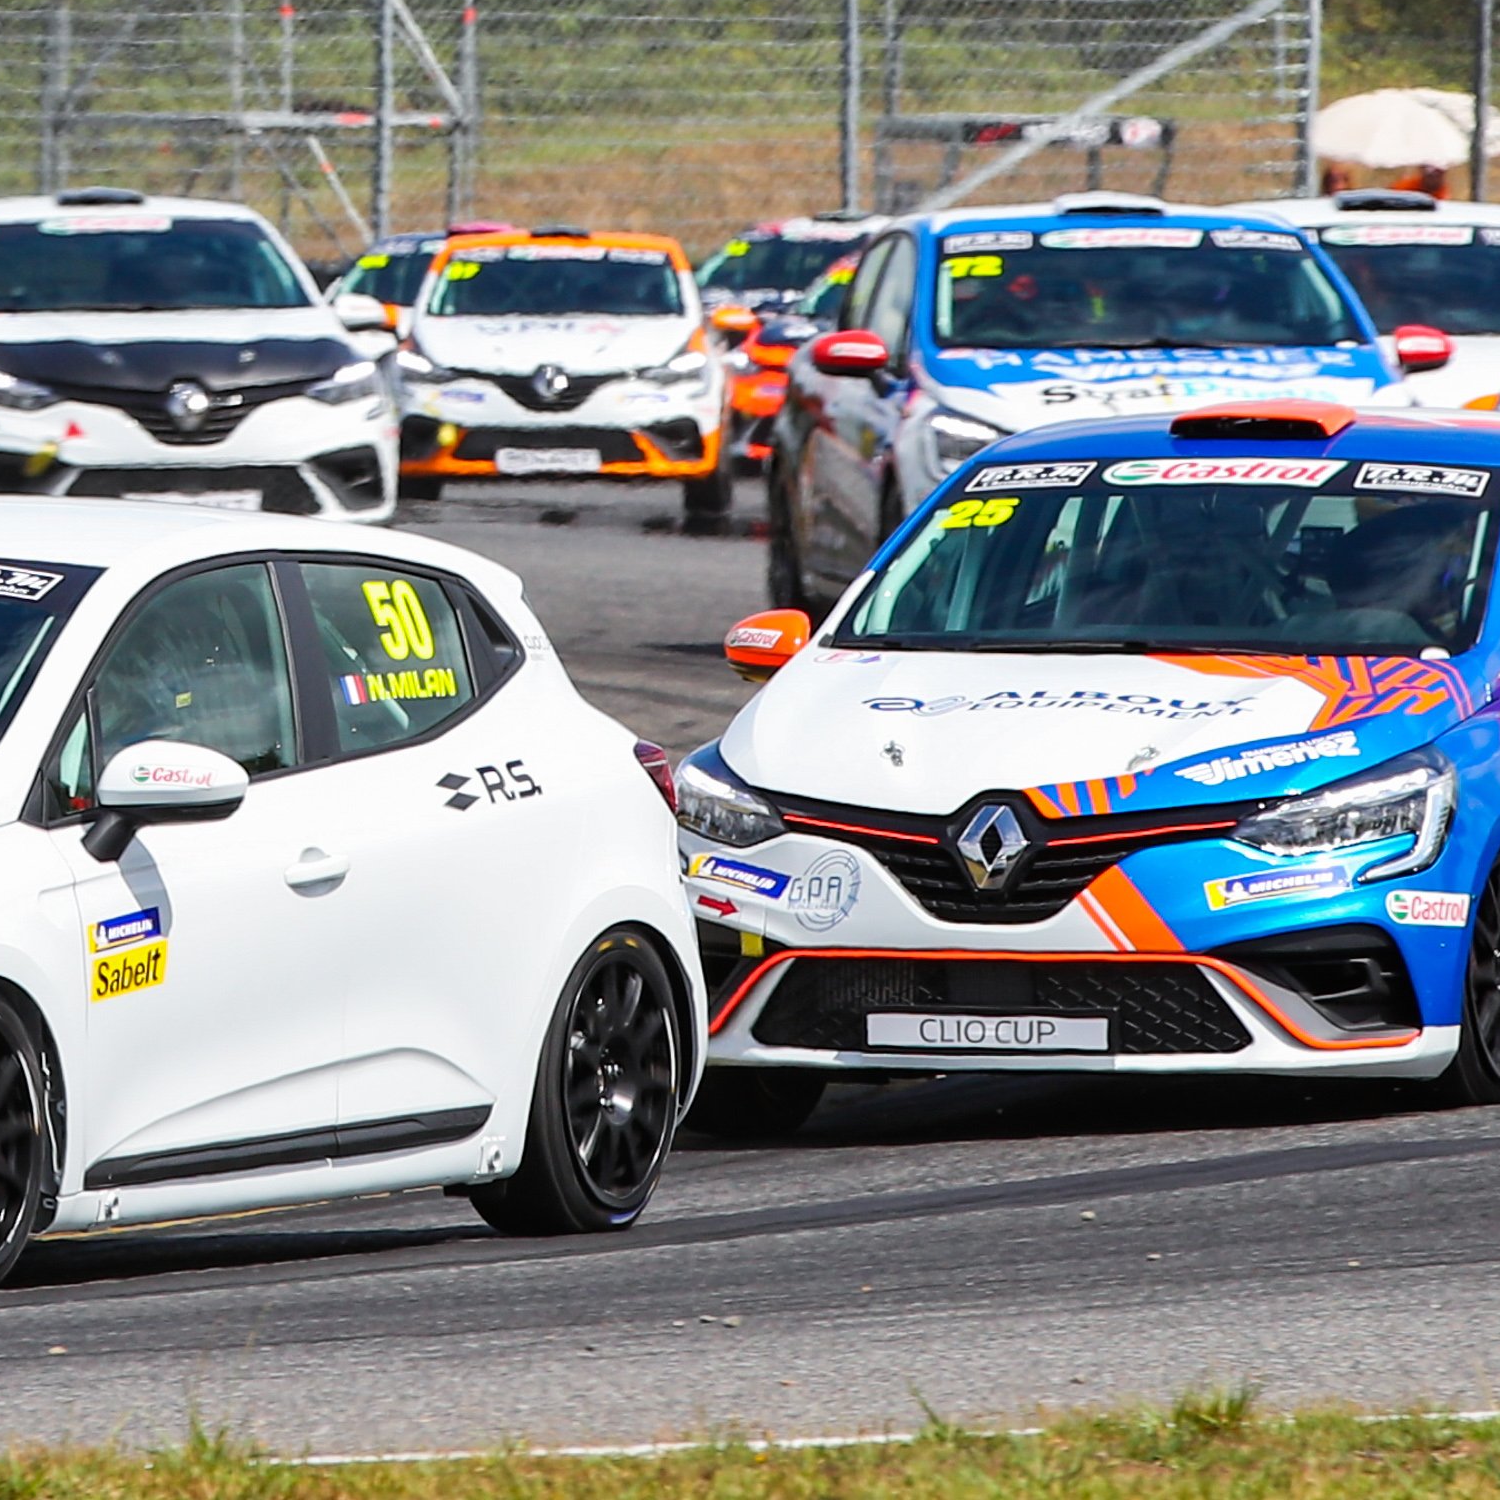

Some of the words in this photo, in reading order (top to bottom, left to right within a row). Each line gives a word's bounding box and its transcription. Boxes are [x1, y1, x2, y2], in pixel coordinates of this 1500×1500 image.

[945, 255, 1003, 278] 72
[1160, 461, 1332, 482] Castrol
[938, 497, 1021, 529] 25
[361, 579, 435, 660] 50
[365, 667, 457, 702] N.MILAN
[967, 700, 1257, 721] EQUIPEMENT
[982, 689, 1259, 712] ALBOUY
[1201, 737, 1362, 786] Jimenez
[713, 865, 777, 890] MICHELIN
[1249, 871, 1334, 895] MICHELIN
[1411, 895, 1466, 922] Castrol
[96, 947, 162, 997] Sabelt
[919, 1018, 986, 1044] CLIO
[994, 1019, 1056, 1045] CUP
